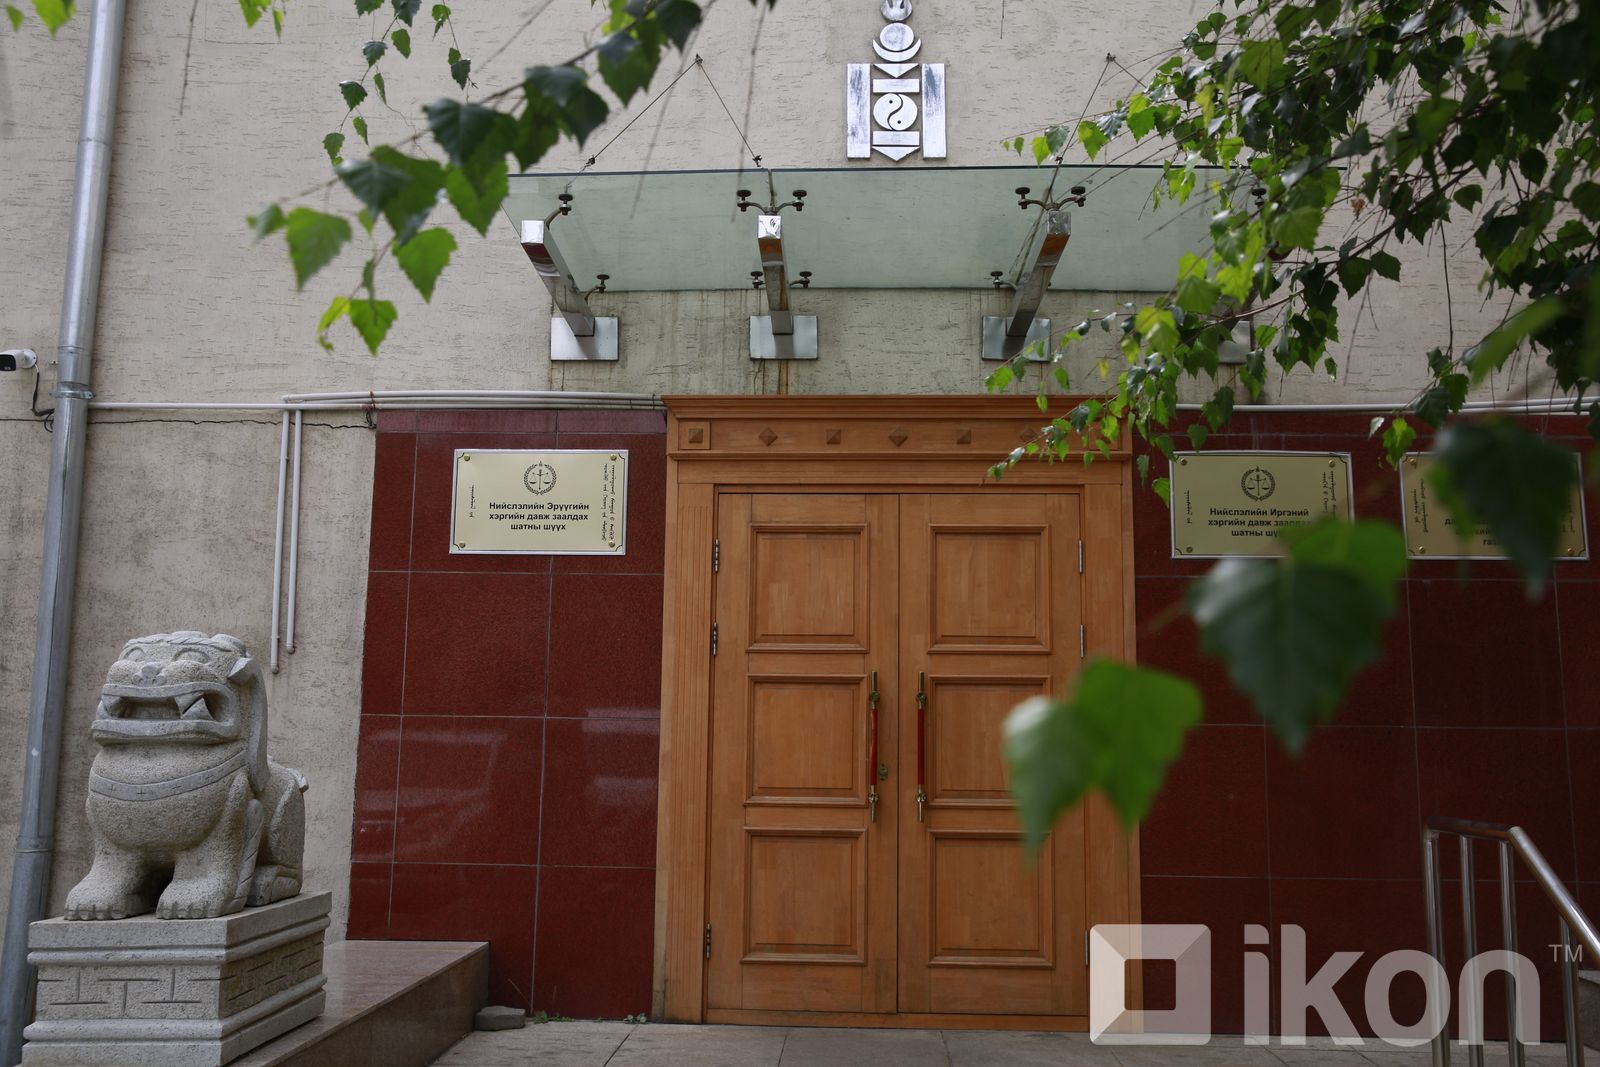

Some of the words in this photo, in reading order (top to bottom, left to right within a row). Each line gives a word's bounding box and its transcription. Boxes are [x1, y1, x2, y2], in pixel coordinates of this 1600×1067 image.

[489, 502, 545, 510] Нийслэлийн
[547, 502, 590, 512] Эрүүгийн
[489, 513, 525, 522] хэргийн
[1209, 508, 1268, 517] Нийслэлийн
[1270, 508, 1309, 518] Иргэний
[1208, 518, 1246, 527] хэргийн
